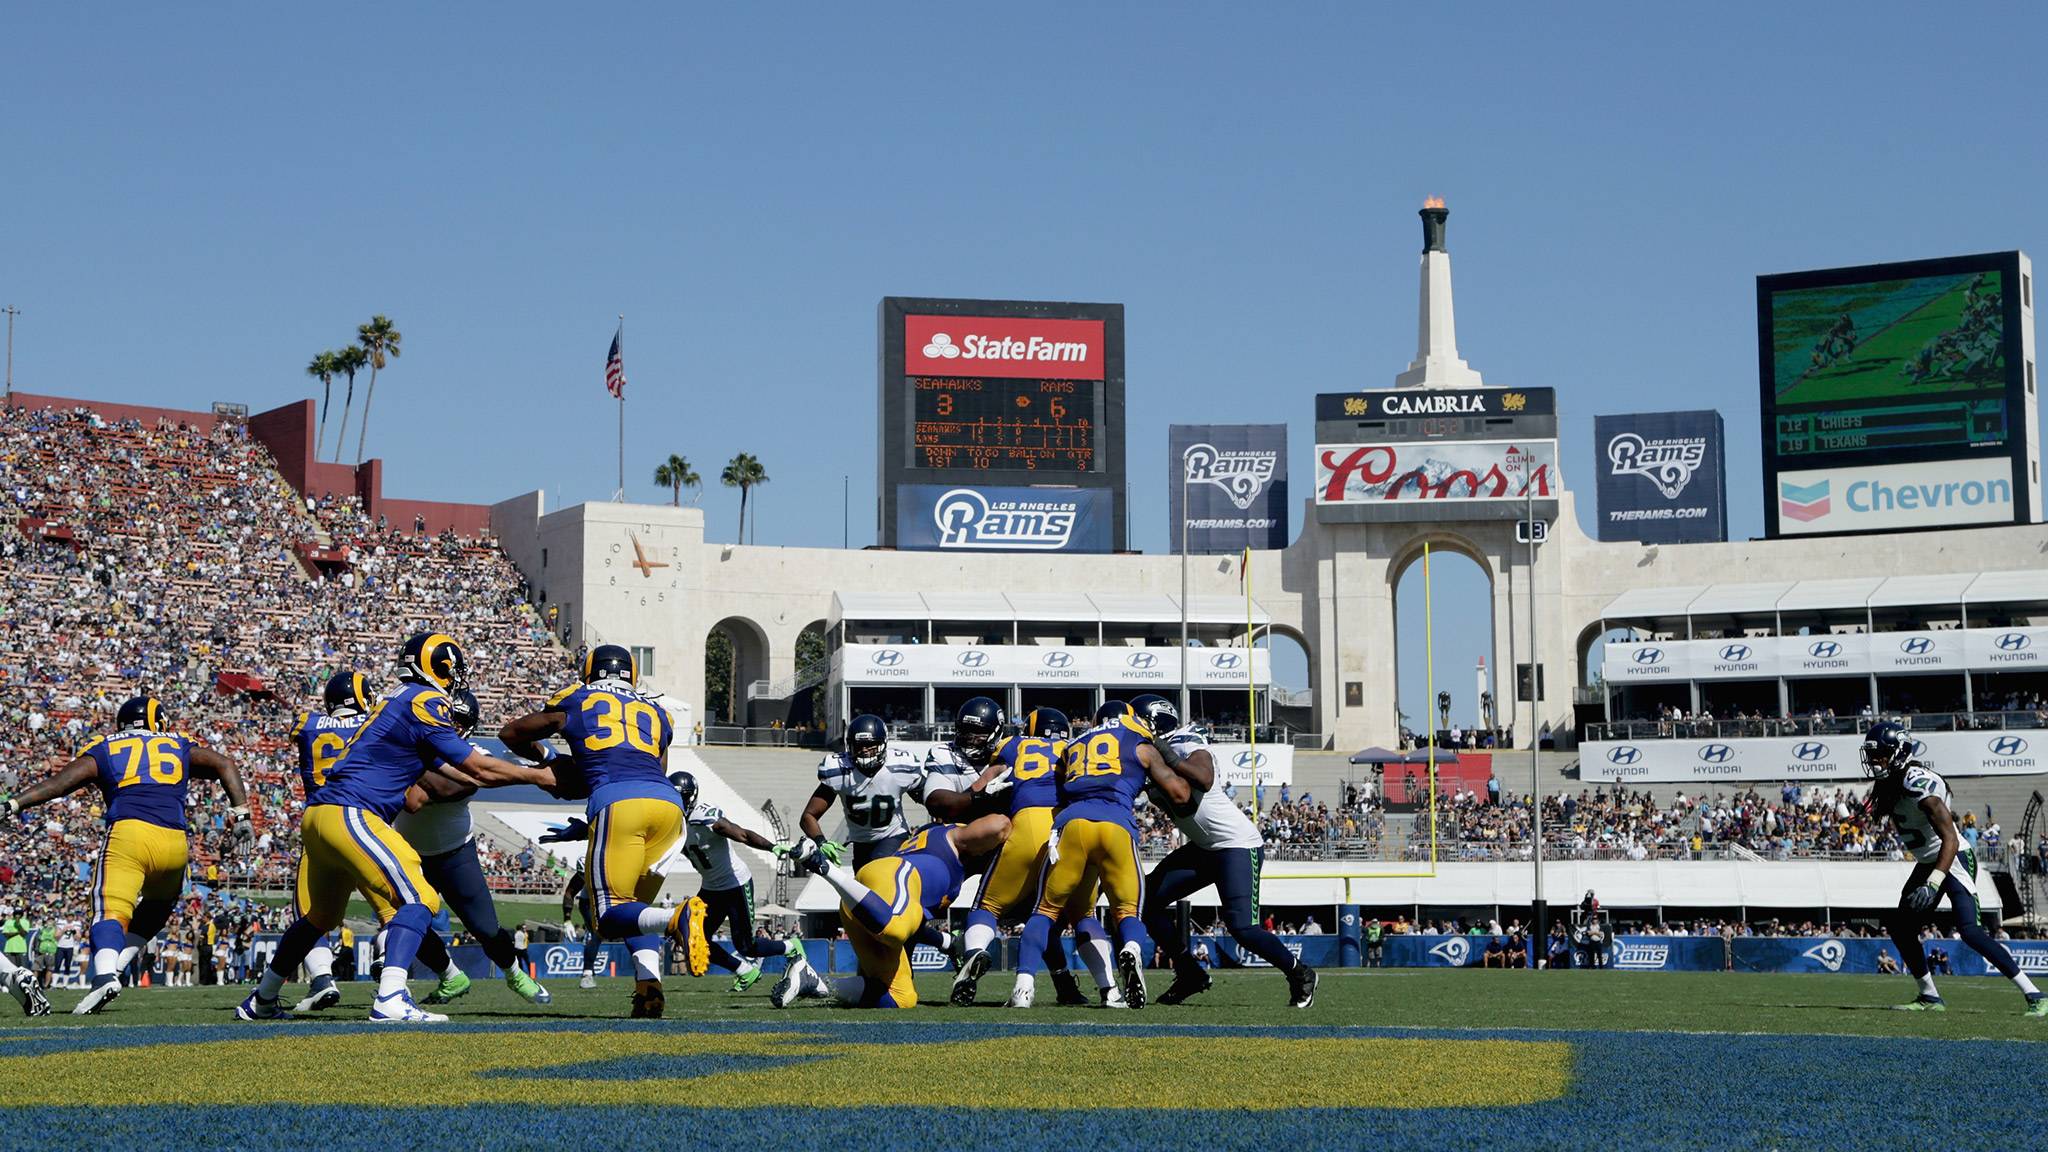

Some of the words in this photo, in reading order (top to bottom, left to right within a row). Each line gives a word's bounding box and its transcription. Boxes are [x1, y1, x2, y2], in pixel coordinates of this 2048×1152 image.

[915, 377, 983, 391] SEAHAWKS
[1040, 381, 1075, 393] RAMS
[937, 394, 953, 415] 3
[1050, 396, 1067, 418] 6
[1382, 395, 1486, 415] CAMBRIA
[1787, 419, 1802, 432] 12
[1821, 415, 1863, 430] CHIEFS
[1821, 434, 1868, 449] TEXANS
[1008, 449, 1037, 459] BALL
[1608, 433, 1706, 475] Rams
[974, 457, 990, 469] 10
[1026, 459, 1037, 470] 5
[1077, 459, 1087, 471] 3
[1183, 443, 1277, 484] Rams
[1505, 455, 1536, 464] CLIMB
[1505, 464, 1521, 472] ON
[1846, 478, 2011, 513] Chevron
[991, 501, 1016, 511] LOS
[1018, 503, 1077, 511] ANGELES
[934, 488, 1077, 549] Rams
[1609, 507, 1708, 522] THERAMS.COM
[1895, 656, 1942, 666] HYUNDAI
[1990, 652, 2038, 662] HYUNDAI
[1714, 663, 1758, 672] HYUNDAI
[1804, 660, 1849, 669] HYUNDAI
[952, 669, 995, 677] HYUNDAI
[1037, 670, 1079, 678] HYUNDAI
[1122, 671, 1164, 679] HYUNDAI
[1206, 671, 1248, 679] HYUNDAI
[1627, 666, 1670, 675] HYUNDAI
[581, 692, 663, 758] 30
[108, 737, 183, 788] 76
[1787, 763, 1837, 772] HYUNDAI
[1982, 758, 2035, 768] HYUNDAI
[1602, 767, 1649, 776] HYUNDAI
[1693, 765, 1742, 774] HYUNDAI
[912, 950, 948, 969] ams
